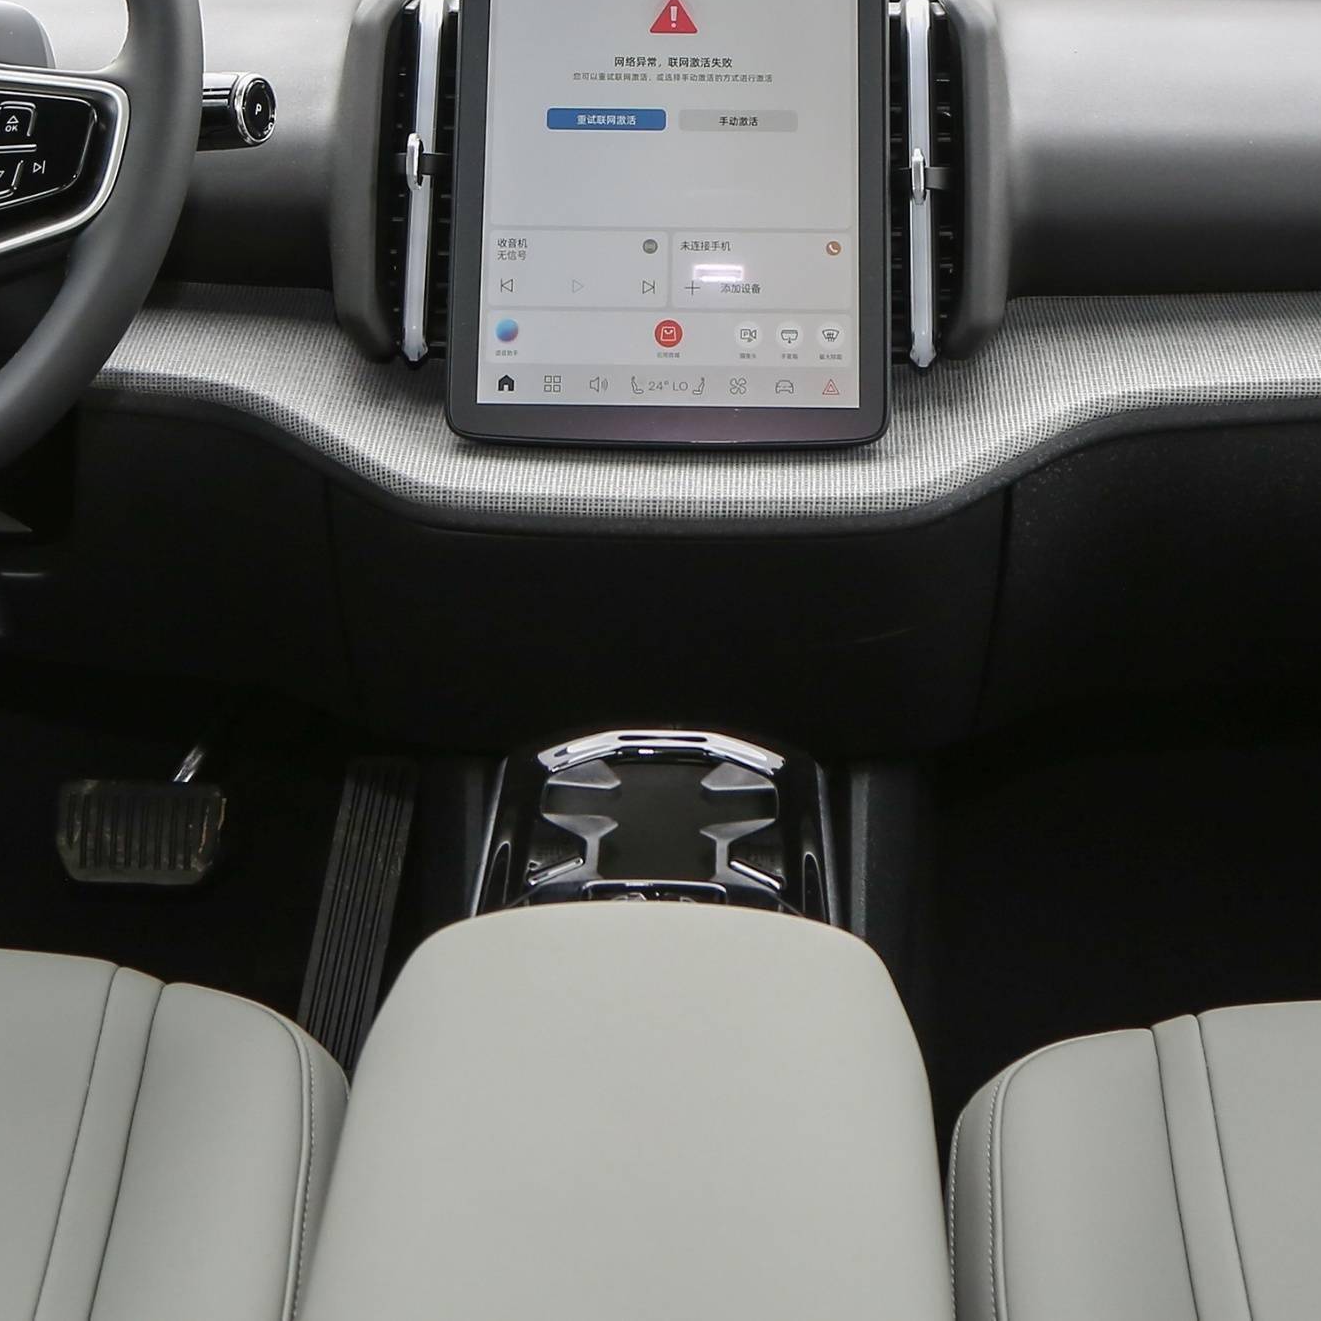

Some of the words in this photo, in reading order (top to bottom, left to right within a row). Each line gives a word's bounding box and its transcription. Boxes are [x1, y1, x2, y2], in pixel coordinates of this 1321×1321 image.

[614, 56, 733, 68] 网络异常，联网激活失败
[255, 103, 262, 115] P
[577, 114, 637, 126] 重试联网激活
[719, 116, 759, 127] 手动激活
[5, 125, 18, 133] OK
[497, 238, 528, 249] 收音机
[680, 241, 731, 251] 未连接手机
[497, 250, 527, 261] 无信号
[720, 283, 761, 294] 添加设备
[648, 380, 669, 391] 24°
[672, 381, 688, 392] LO
